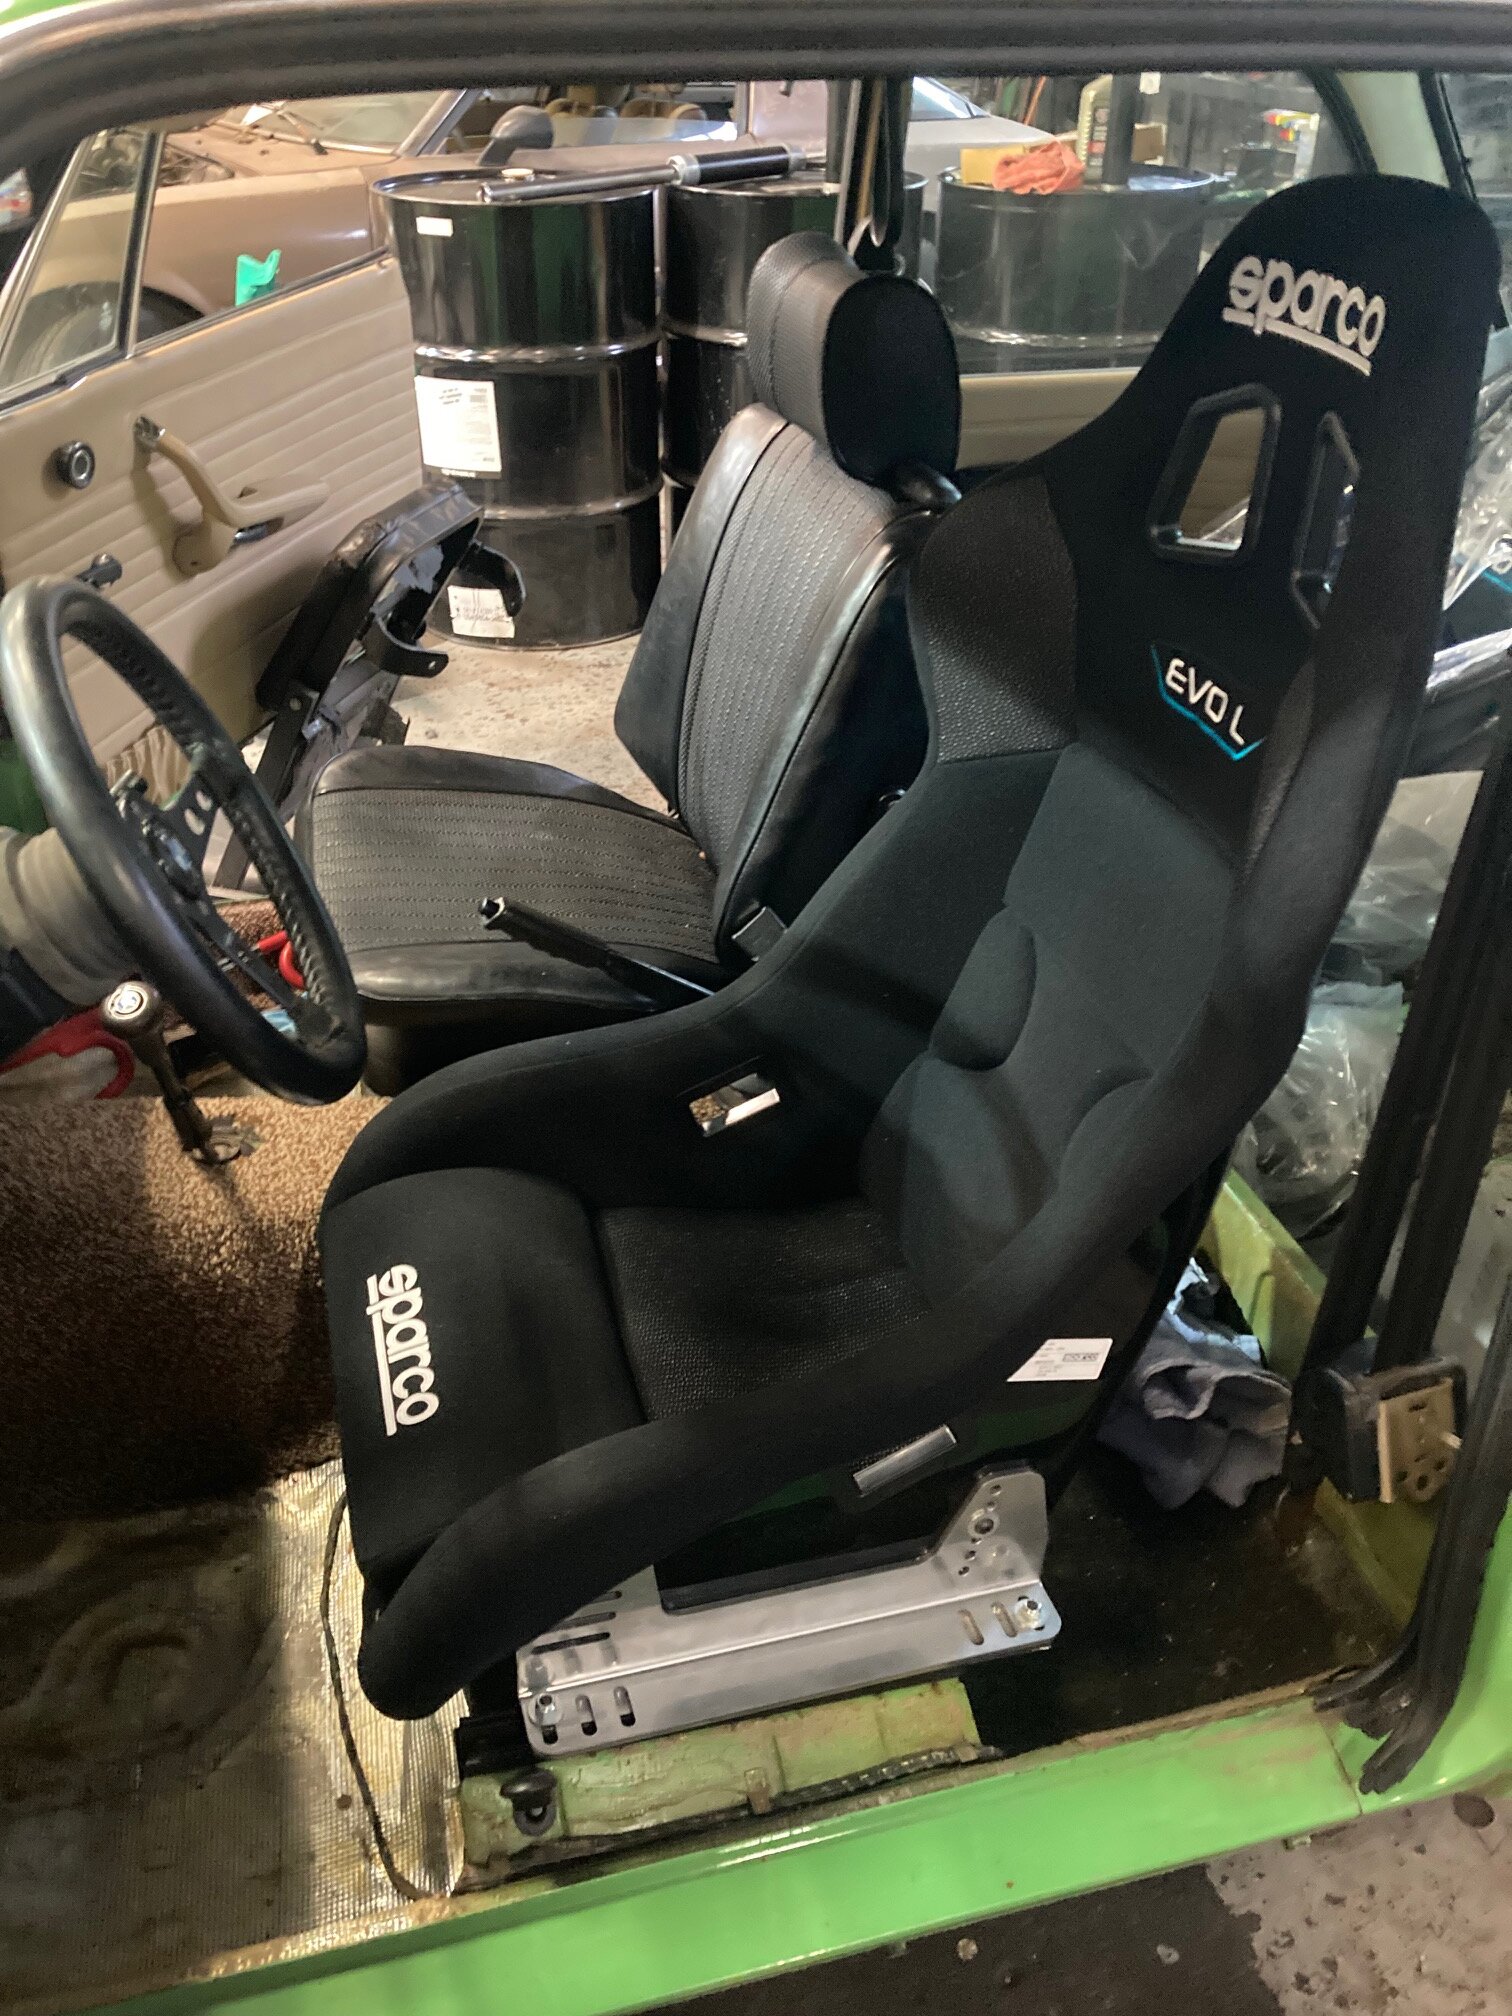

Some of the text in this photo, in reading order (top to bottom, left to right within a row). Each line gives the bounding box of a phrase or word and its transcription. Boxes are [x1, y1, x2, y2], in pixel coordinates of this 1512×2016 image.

[1227, 255, 1387, 358] sparco
[1165, 658, 1245, 746] EVO L
[366, 1263, 440, 1426] sparco
